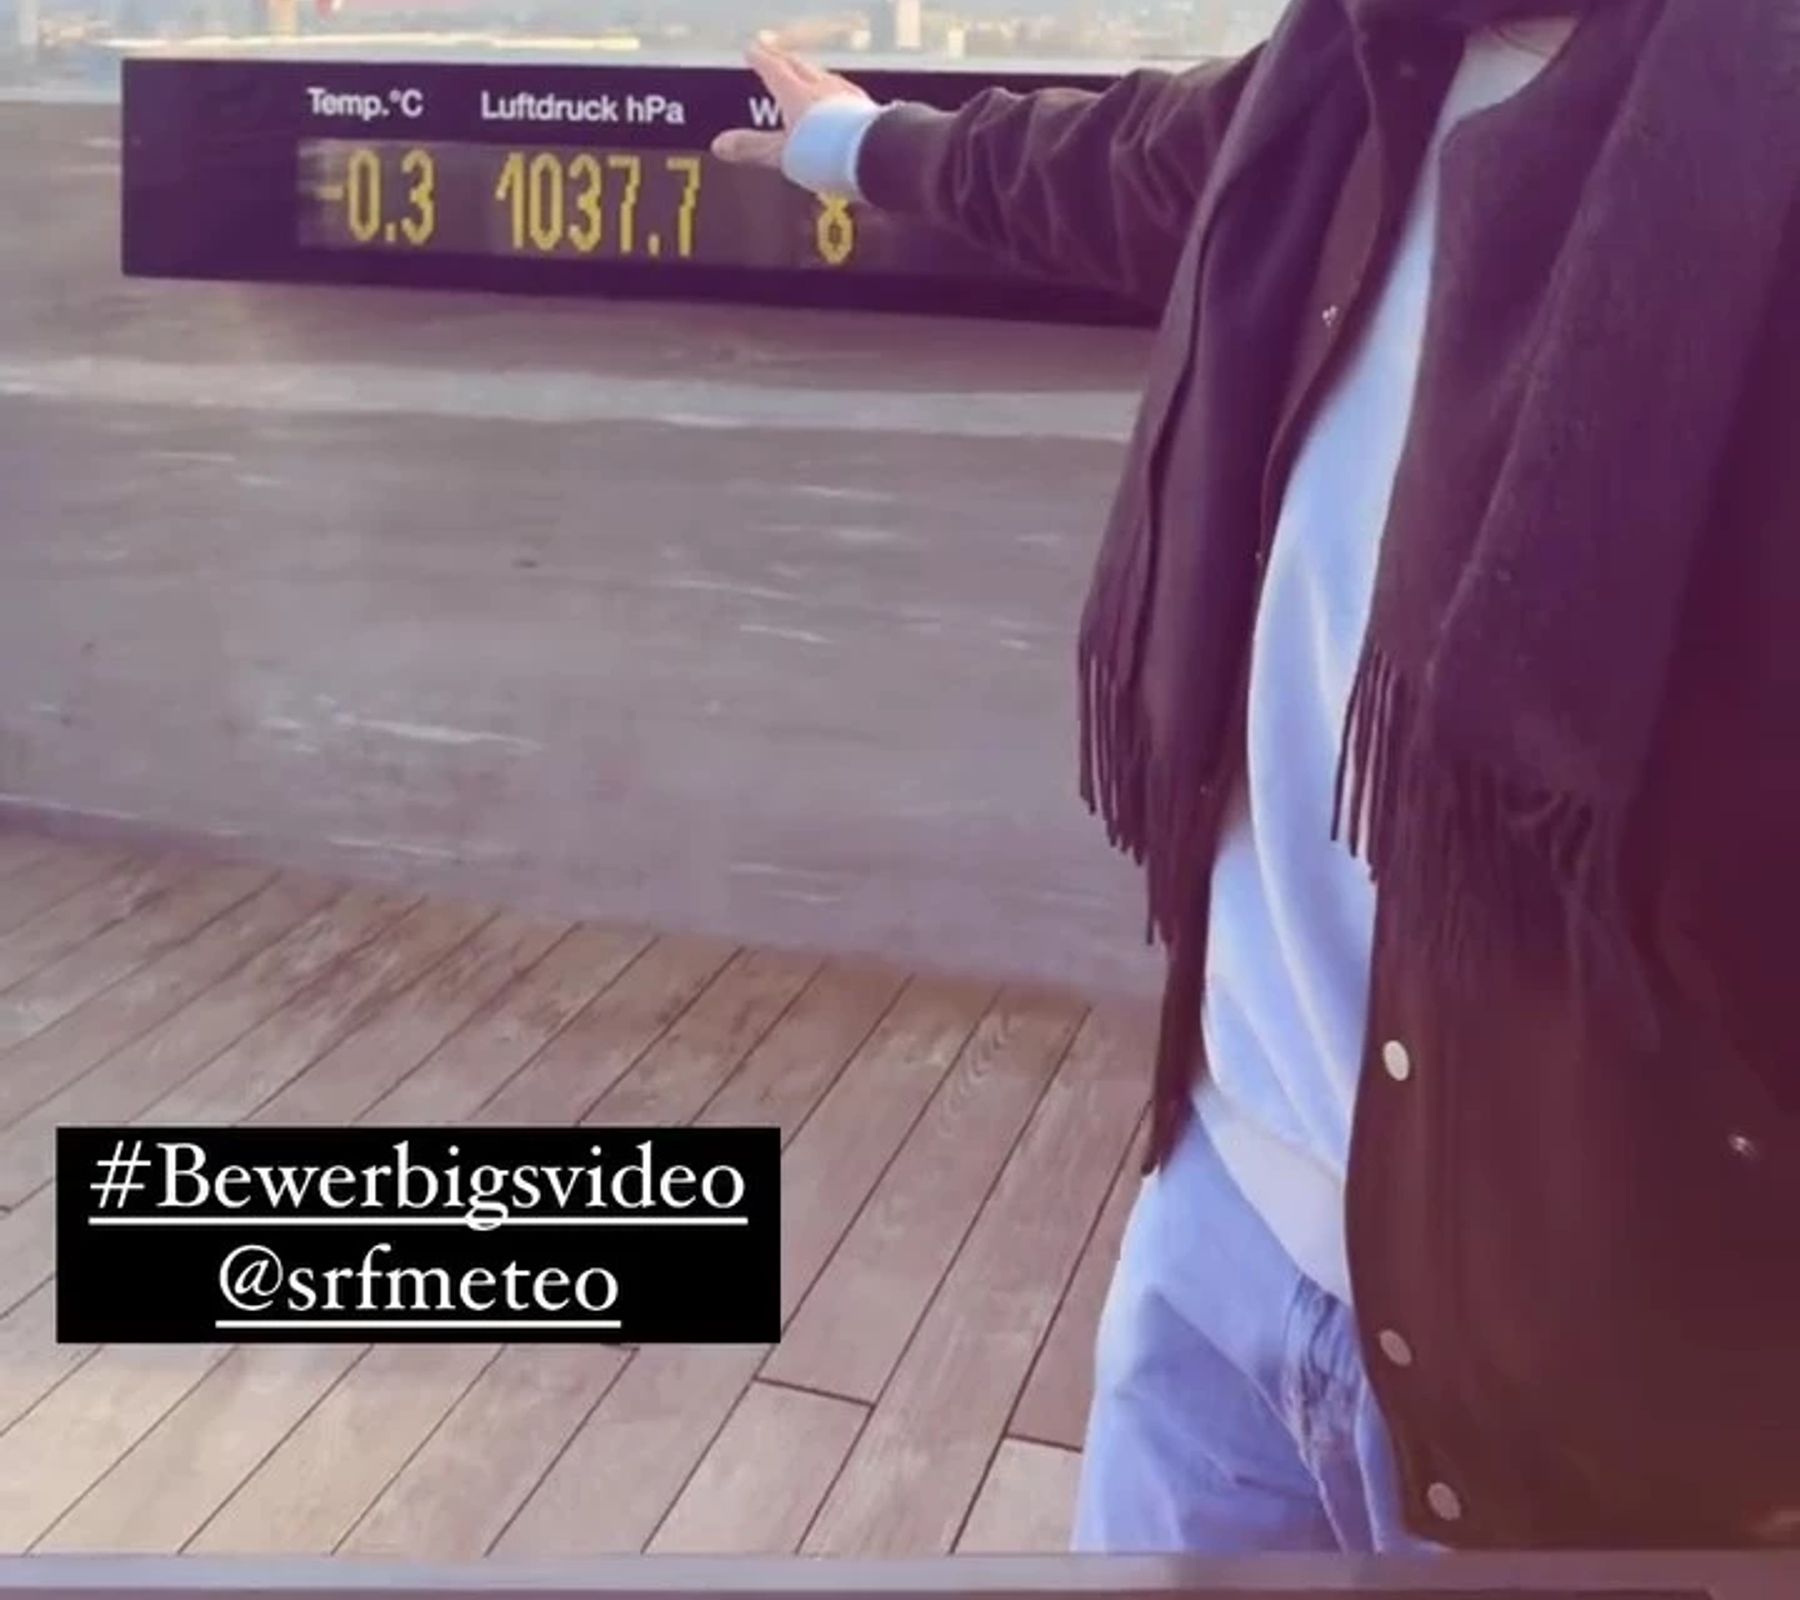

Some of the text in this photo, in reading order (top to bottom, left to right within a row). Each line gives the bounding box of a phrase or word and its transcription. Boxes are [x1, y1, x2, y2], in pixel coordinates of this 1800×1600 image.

[481, 90, 686, 125] Luftdruck hPa
[314, 148, 435, 245] -0.3
[495, 152, 701, 258] 1037.7
